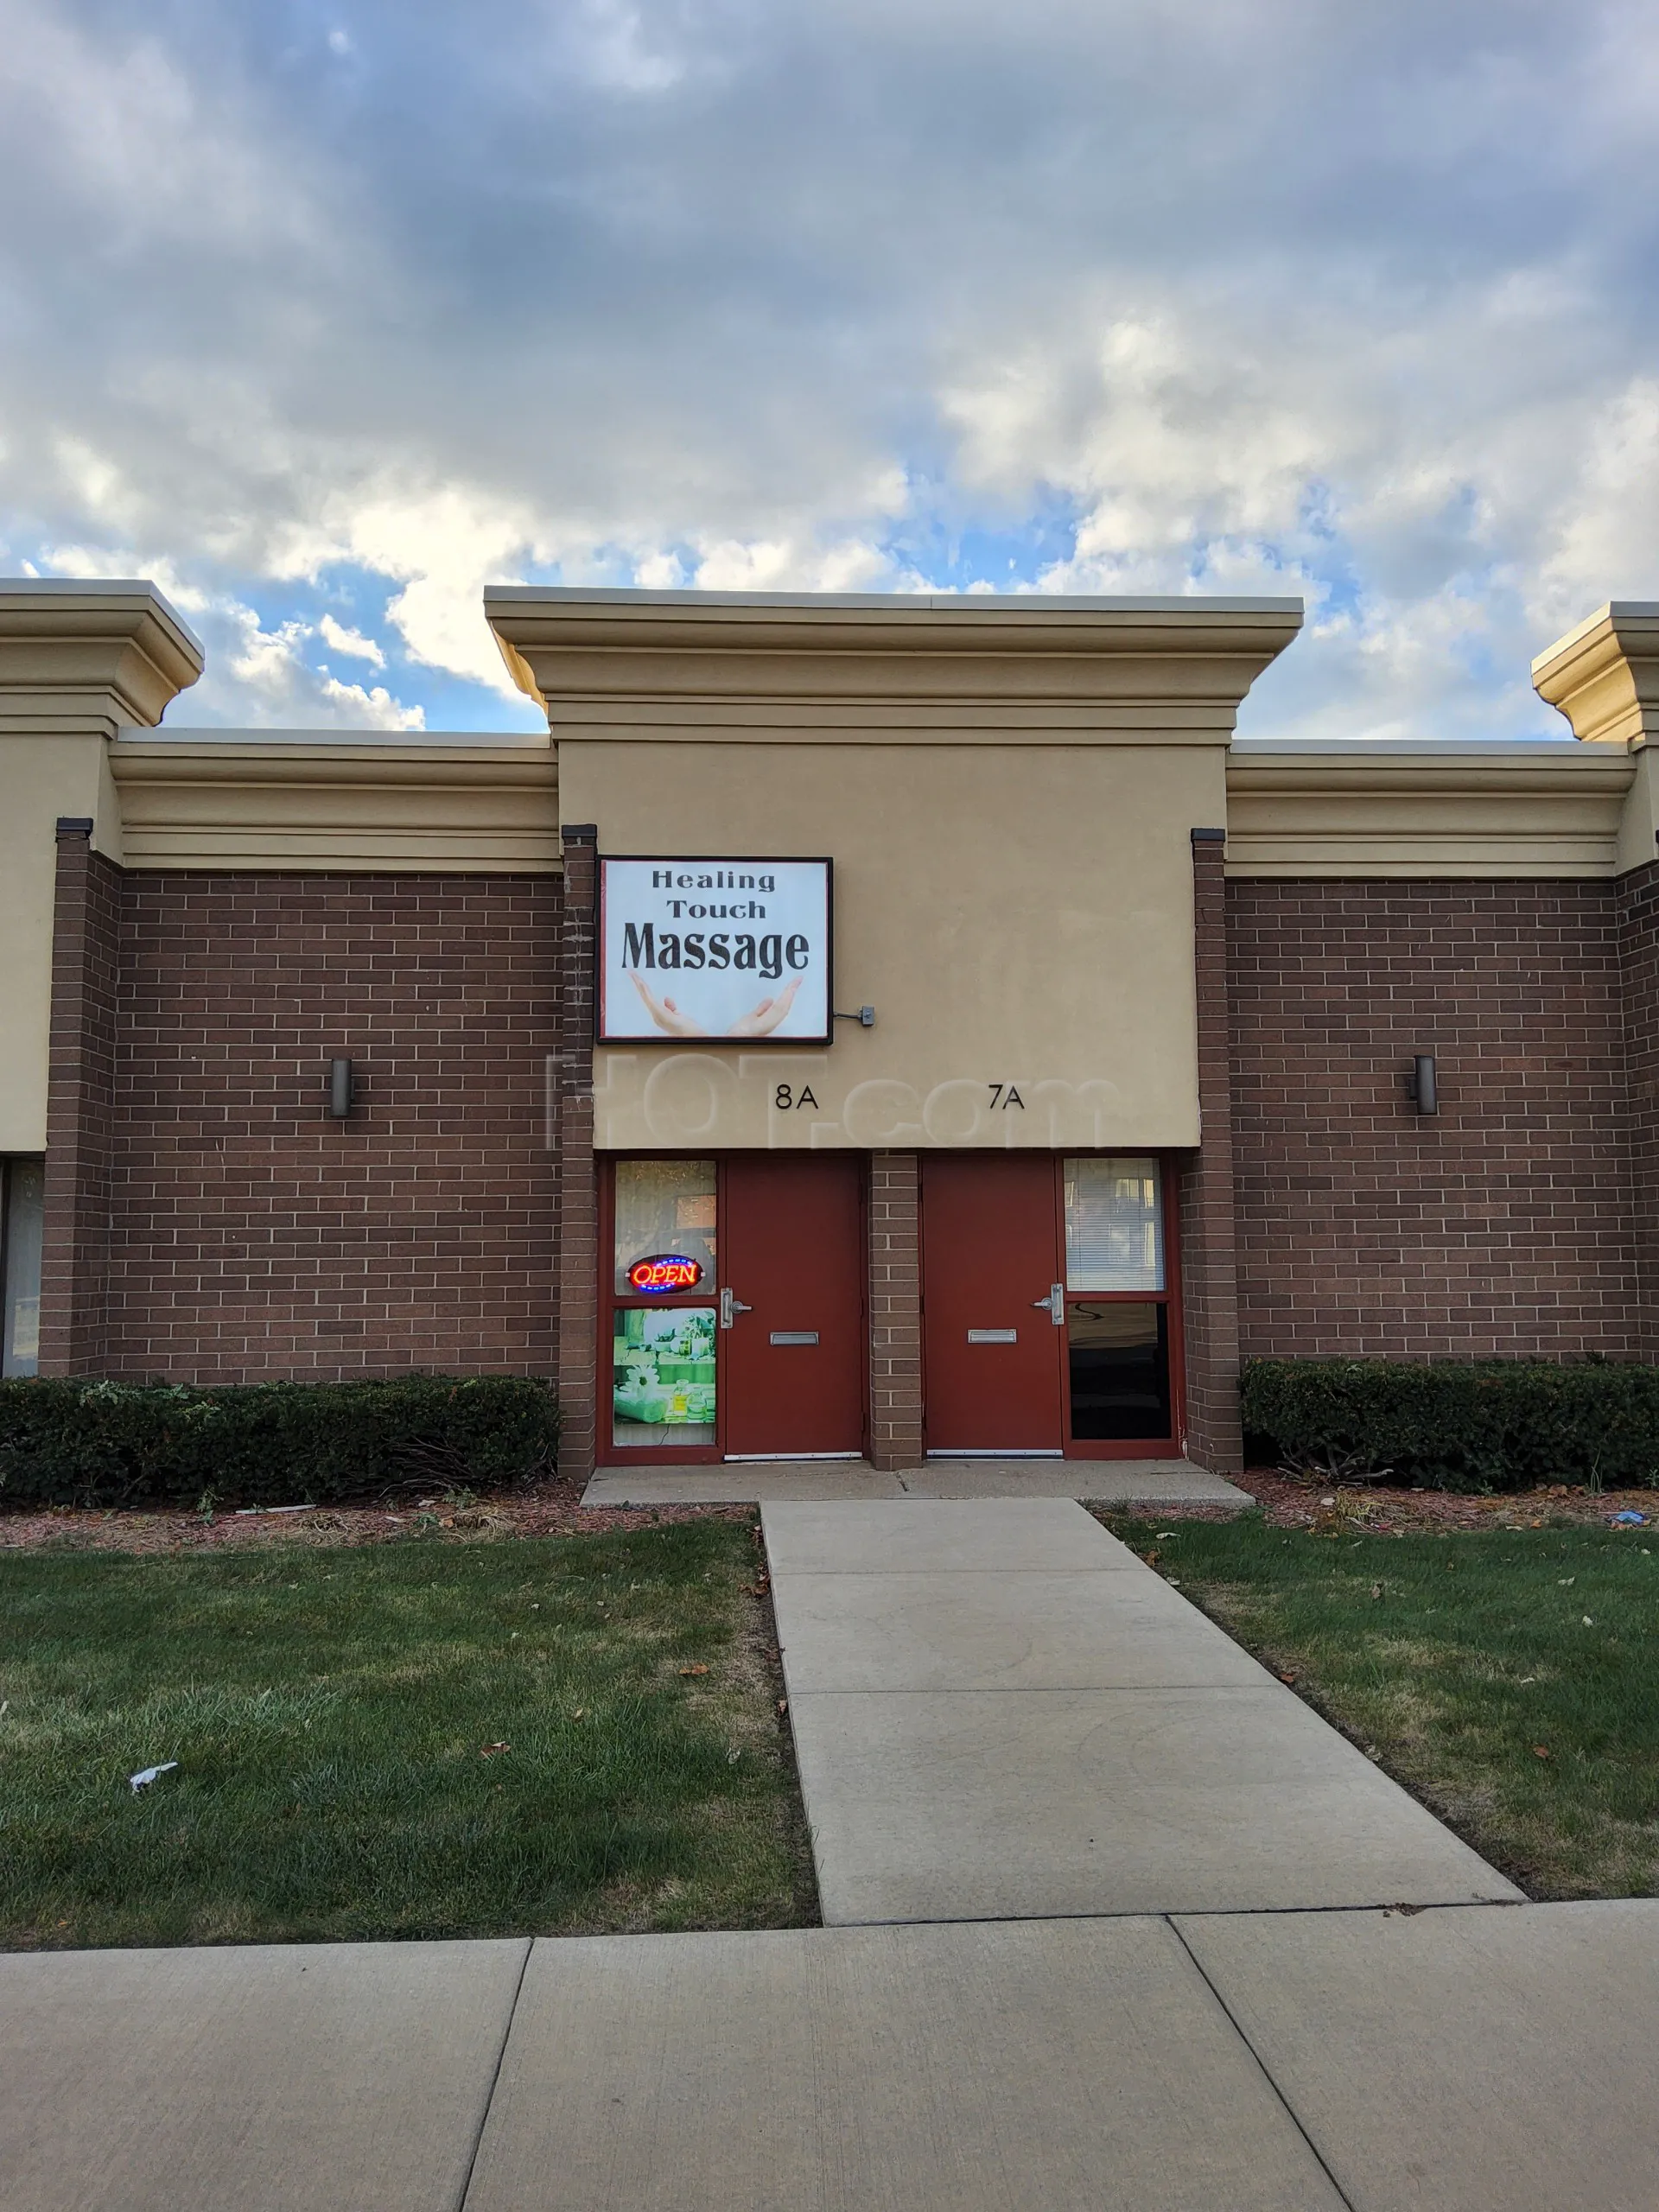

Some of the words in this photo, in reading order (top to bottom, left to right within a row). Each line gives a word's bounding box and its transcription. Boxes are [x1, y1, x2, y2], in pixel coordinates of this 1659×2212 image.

[652, 870, 776, 893] Healing
[666, 899, 766, 919] Touch
[621, 922, 810, 980] Massage
[776, 1084, 819, 1109] 8A
[988, 1084, 1026, 1109] 7A
[632, 1263, 698, 1286] OPEN
